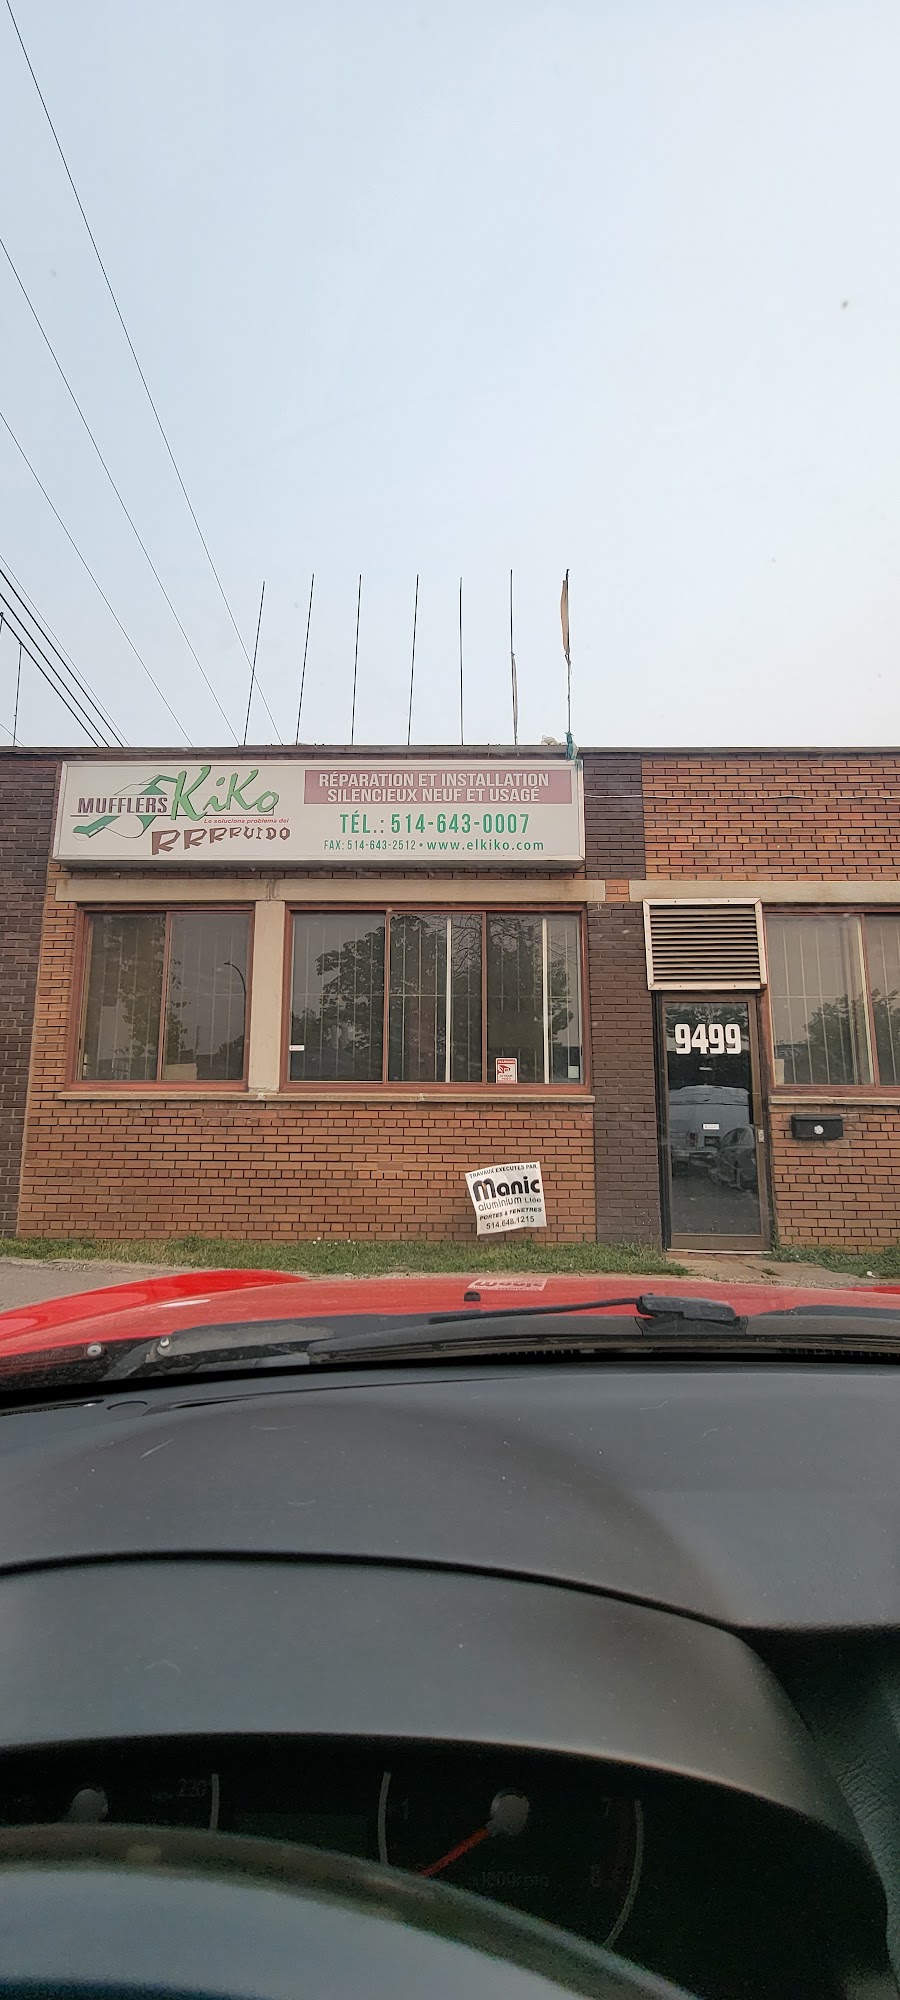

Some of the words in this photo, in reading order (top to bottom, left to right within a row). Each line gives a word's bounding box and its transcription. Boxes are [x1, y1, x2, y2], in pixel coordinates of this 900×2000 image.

[319, 771, 414, 787] RÉPARATION
[419, 773, 437, 787] ET
[441, 773, 549, 787] INSTALLATION
[327, 788, 418, 802] SILENCIEUX
[423, 788, 461, 802] NEUF
[466, 788, 485, 802] ET
[490, 786, 540, 802] USAGÉ
[77, 797, 168, 814] MUFFLERS
[390, 813, 530, 834] 514-643-0007
[323, 840, 345, 851] FAX:
[347, 839, 417, 851] 514-643-2512
[427, 839, 545, 851] www.elkiko.com
[675, 1023, 742, 1055] 9499
[469, 1168, 495, 1179] TRAVAUX
[478, 1196, 522, 1212] aluminium
[479, 1211, 503, 1221] PORTES
